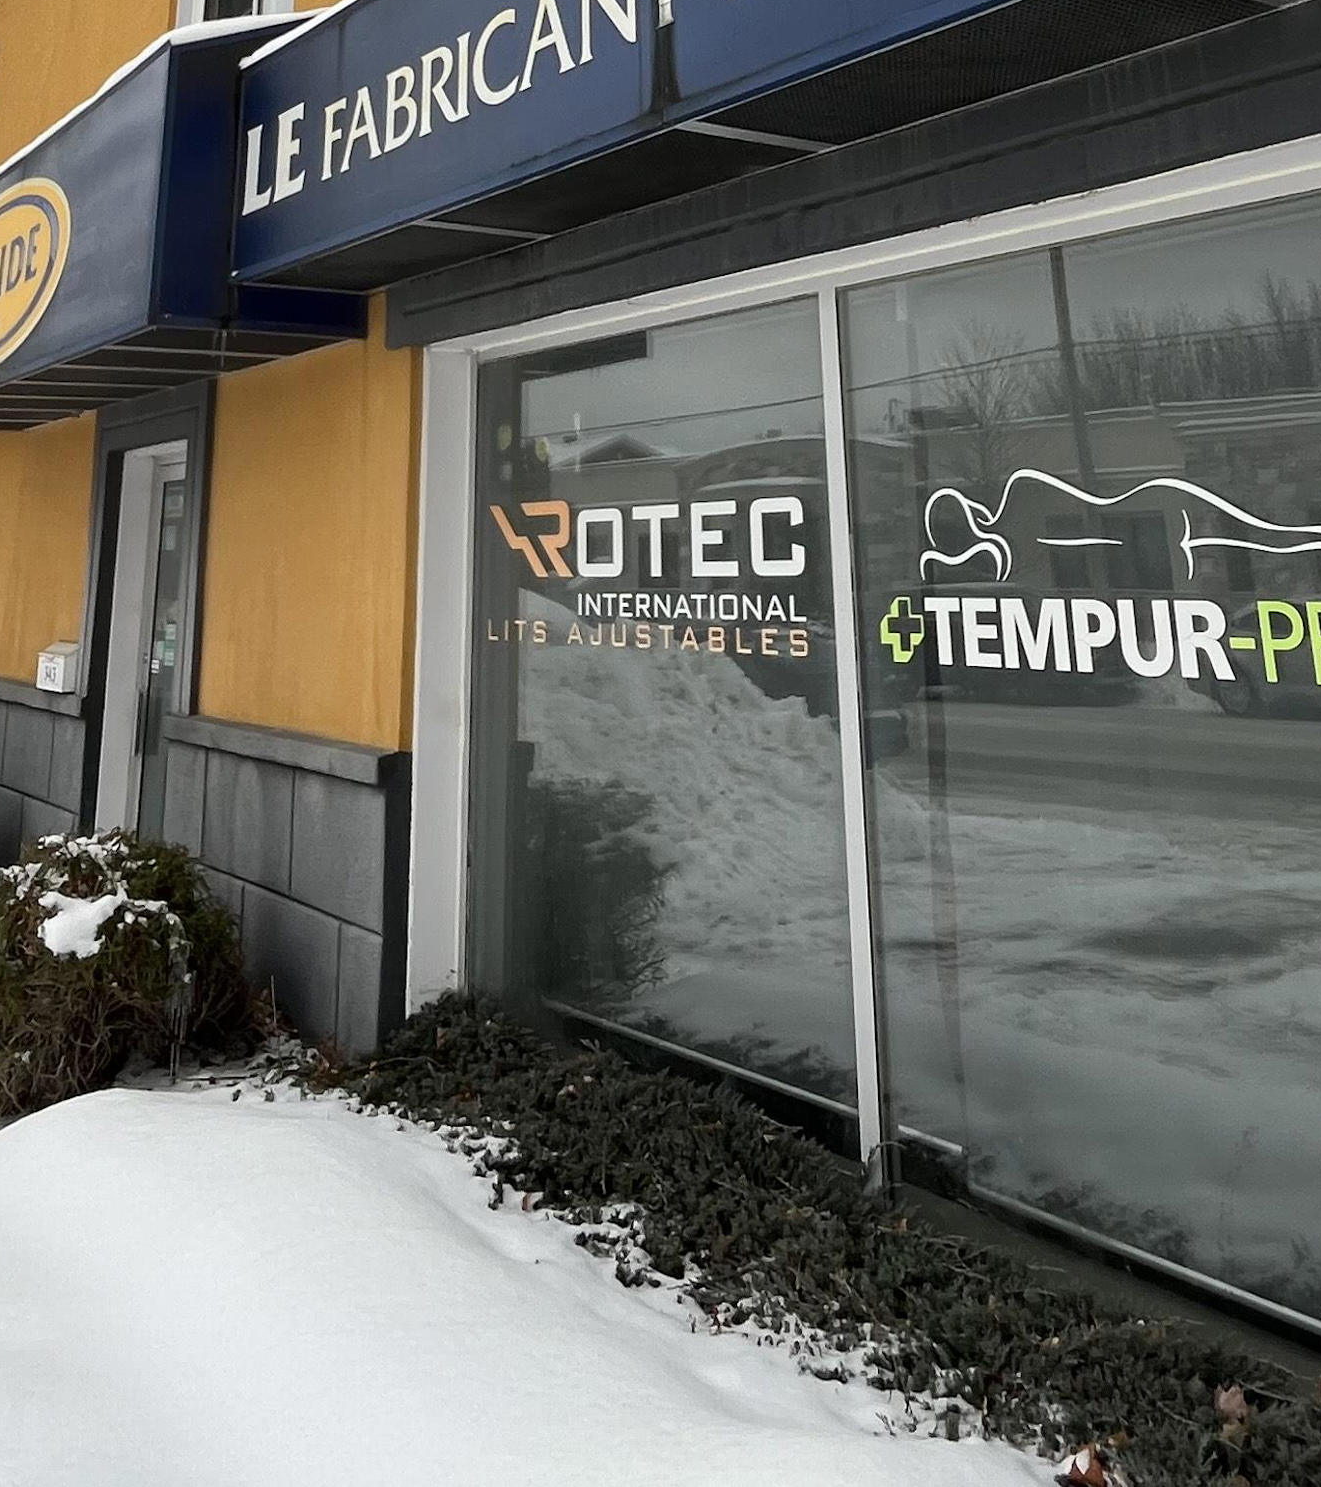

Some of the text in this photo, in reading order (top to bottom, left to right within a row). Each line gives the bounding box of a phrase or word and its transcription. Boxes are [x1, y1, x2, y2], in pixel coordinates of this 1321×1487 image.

[242, 100, 305, 216] LE
[489, 496, 806, 578] ROTEC
[577, 593, 808, 623] INTERNATIONAL
[486, 619, 810, 658] LITS AJUSTABLES
